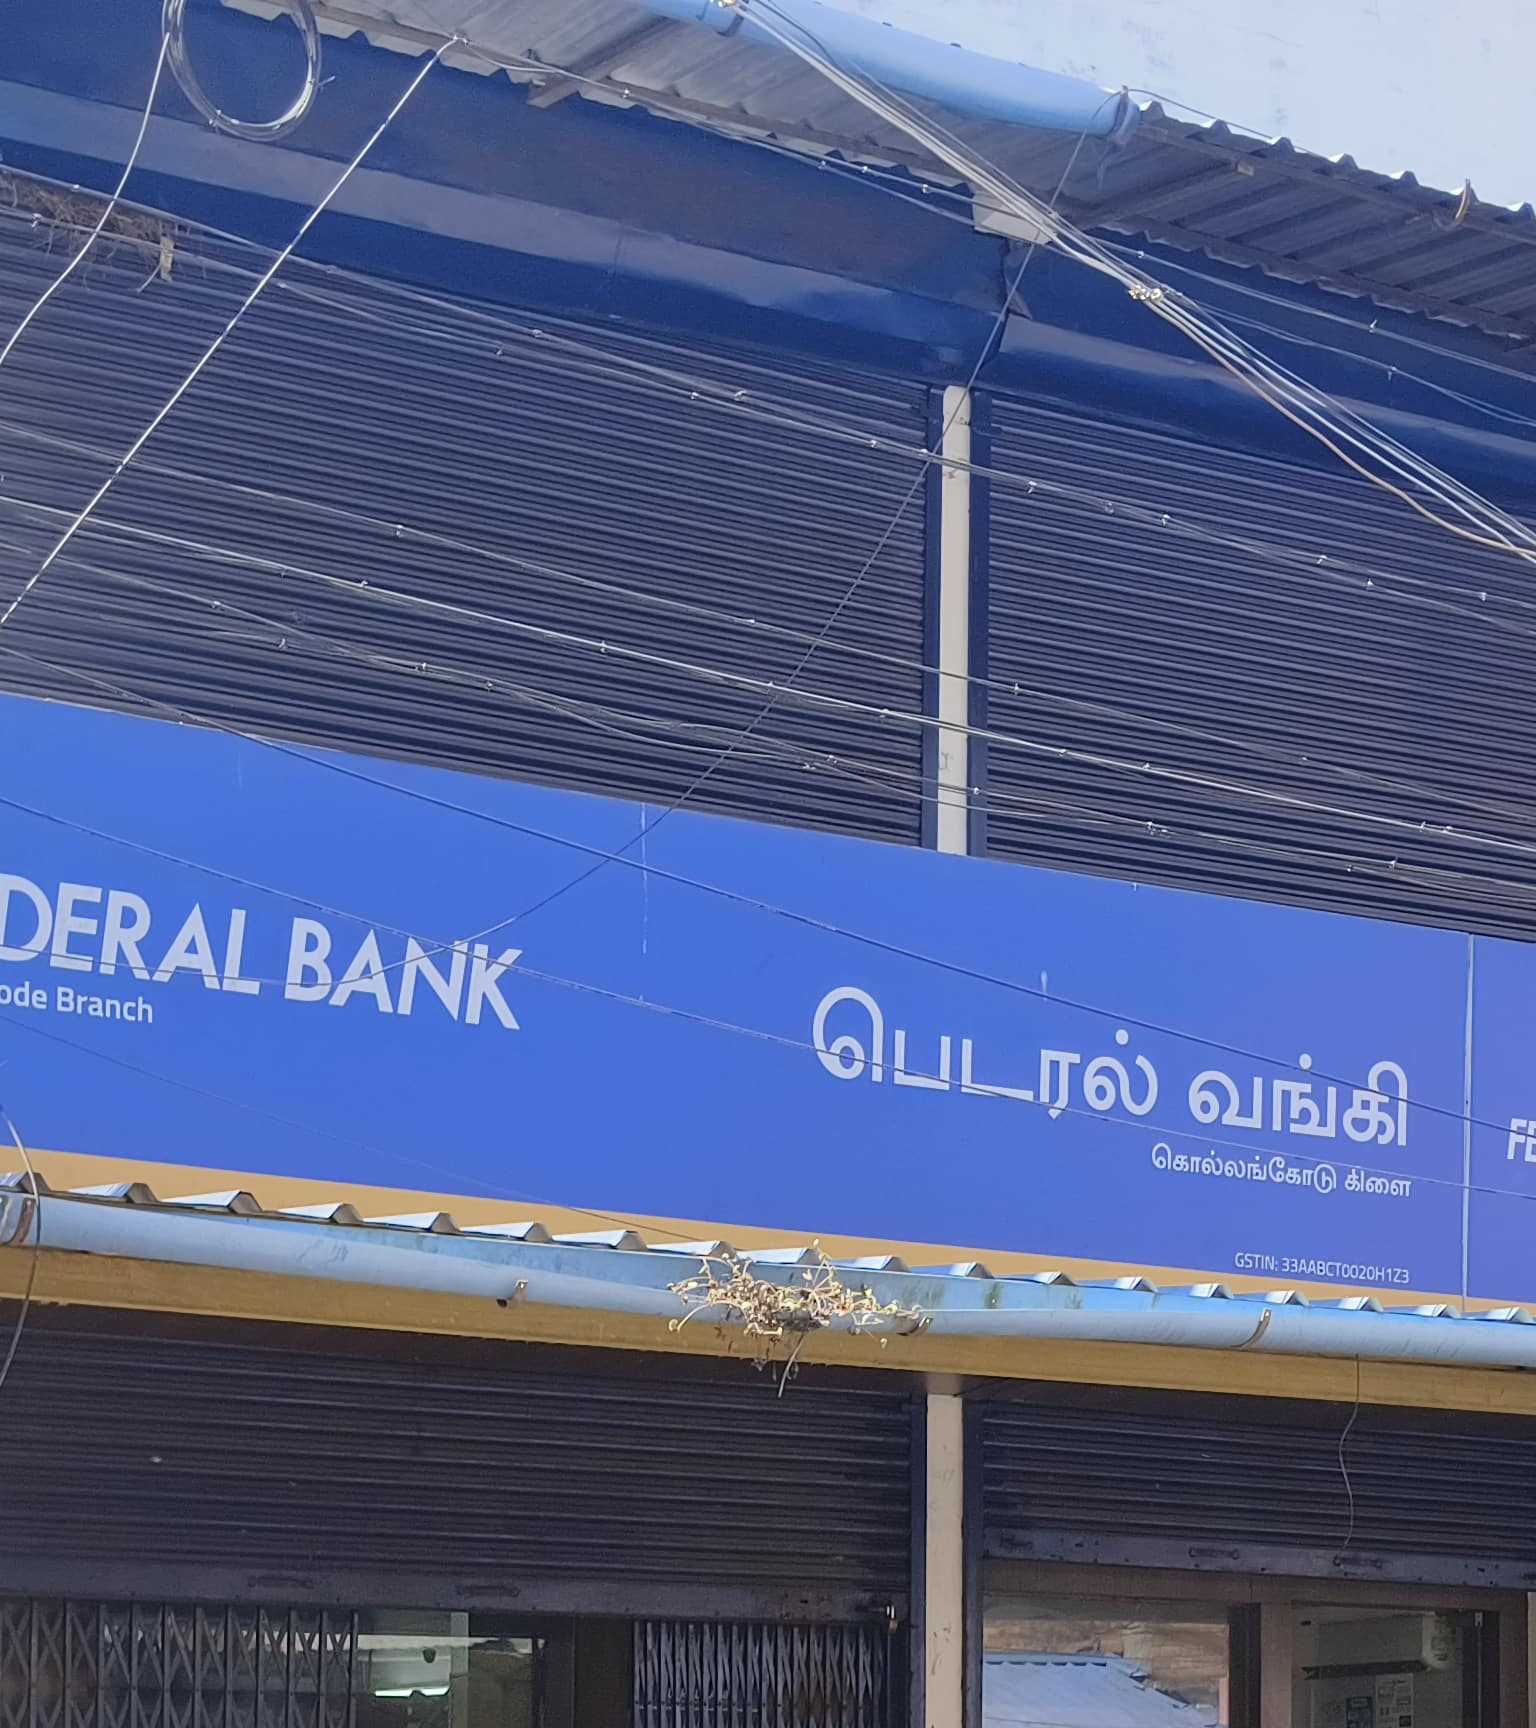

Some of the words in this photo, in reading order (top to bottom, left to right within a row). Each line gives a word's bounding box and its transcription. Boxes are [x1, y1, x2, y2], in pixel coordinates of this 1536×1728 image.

[284, 916, 523, 1031] BANK
[56, 986, 154, 1023] Branch
[812, 986, 1159, 1120] பெடரல்
[1188, 1053, 1408, 1146] வங்கி
[1151, 1142, 1337, 1194] கொல்லங்கோடு
[1344, 1168, 1412, 1198] கிளை
[1234, 1252, 1279, 1272] GSTIN:
